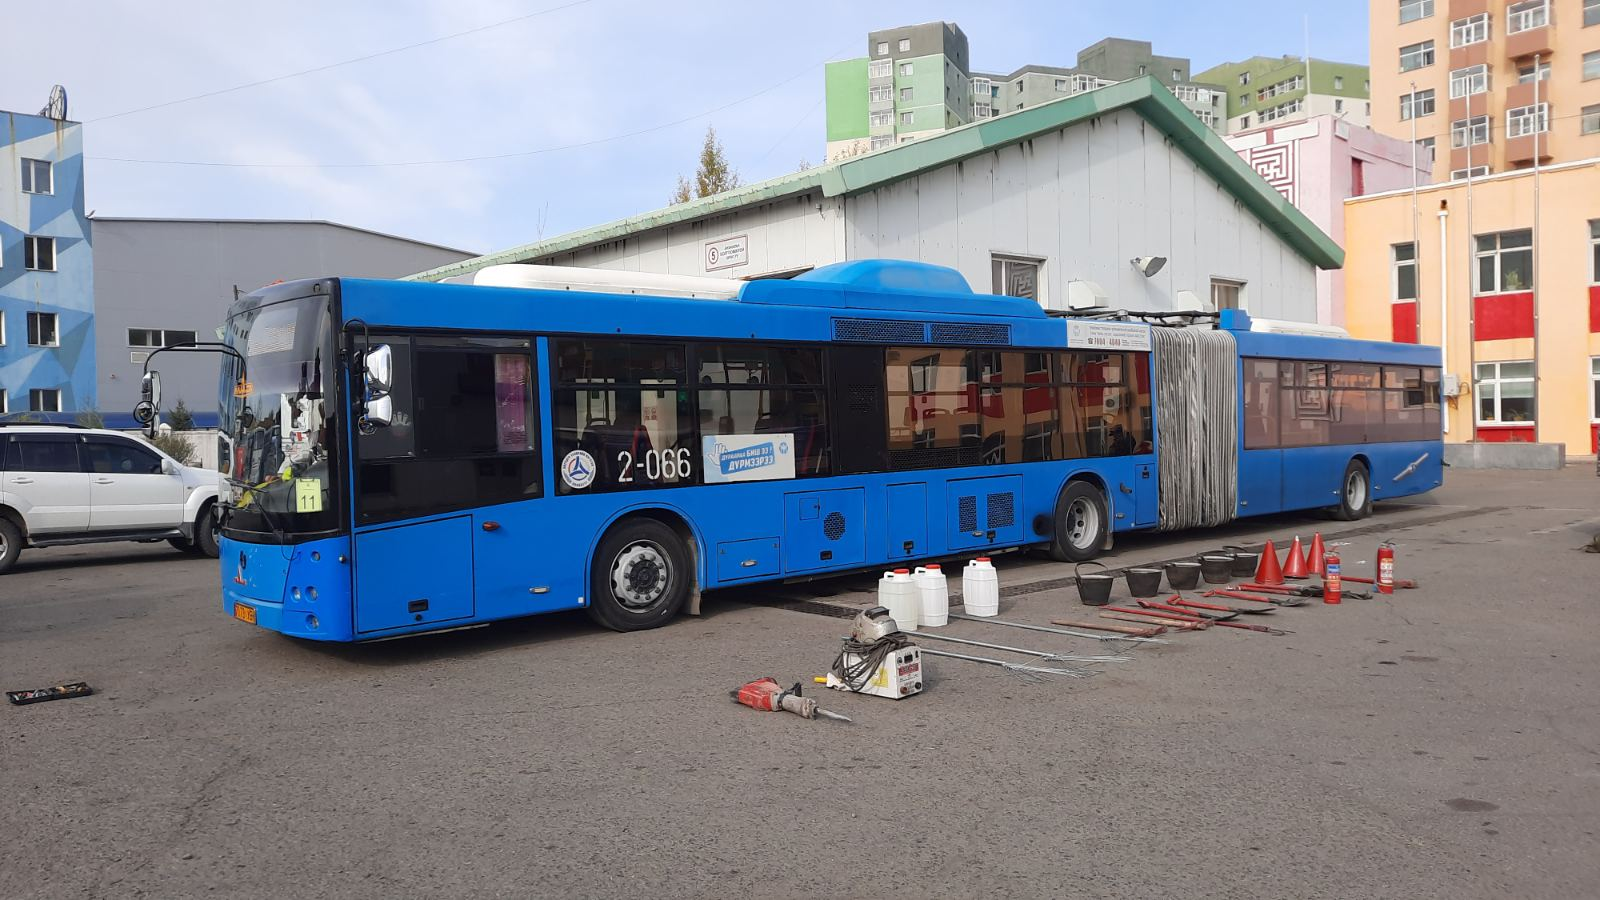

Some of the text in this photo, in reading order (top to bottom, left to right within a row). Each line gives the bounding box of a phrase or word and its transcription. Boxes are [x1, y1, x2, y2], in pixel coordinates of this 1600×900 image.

[711, 251, 716, 261] 5
[617, 447, 691, 483] 2-066
[301, 495, 315, 510] 11
